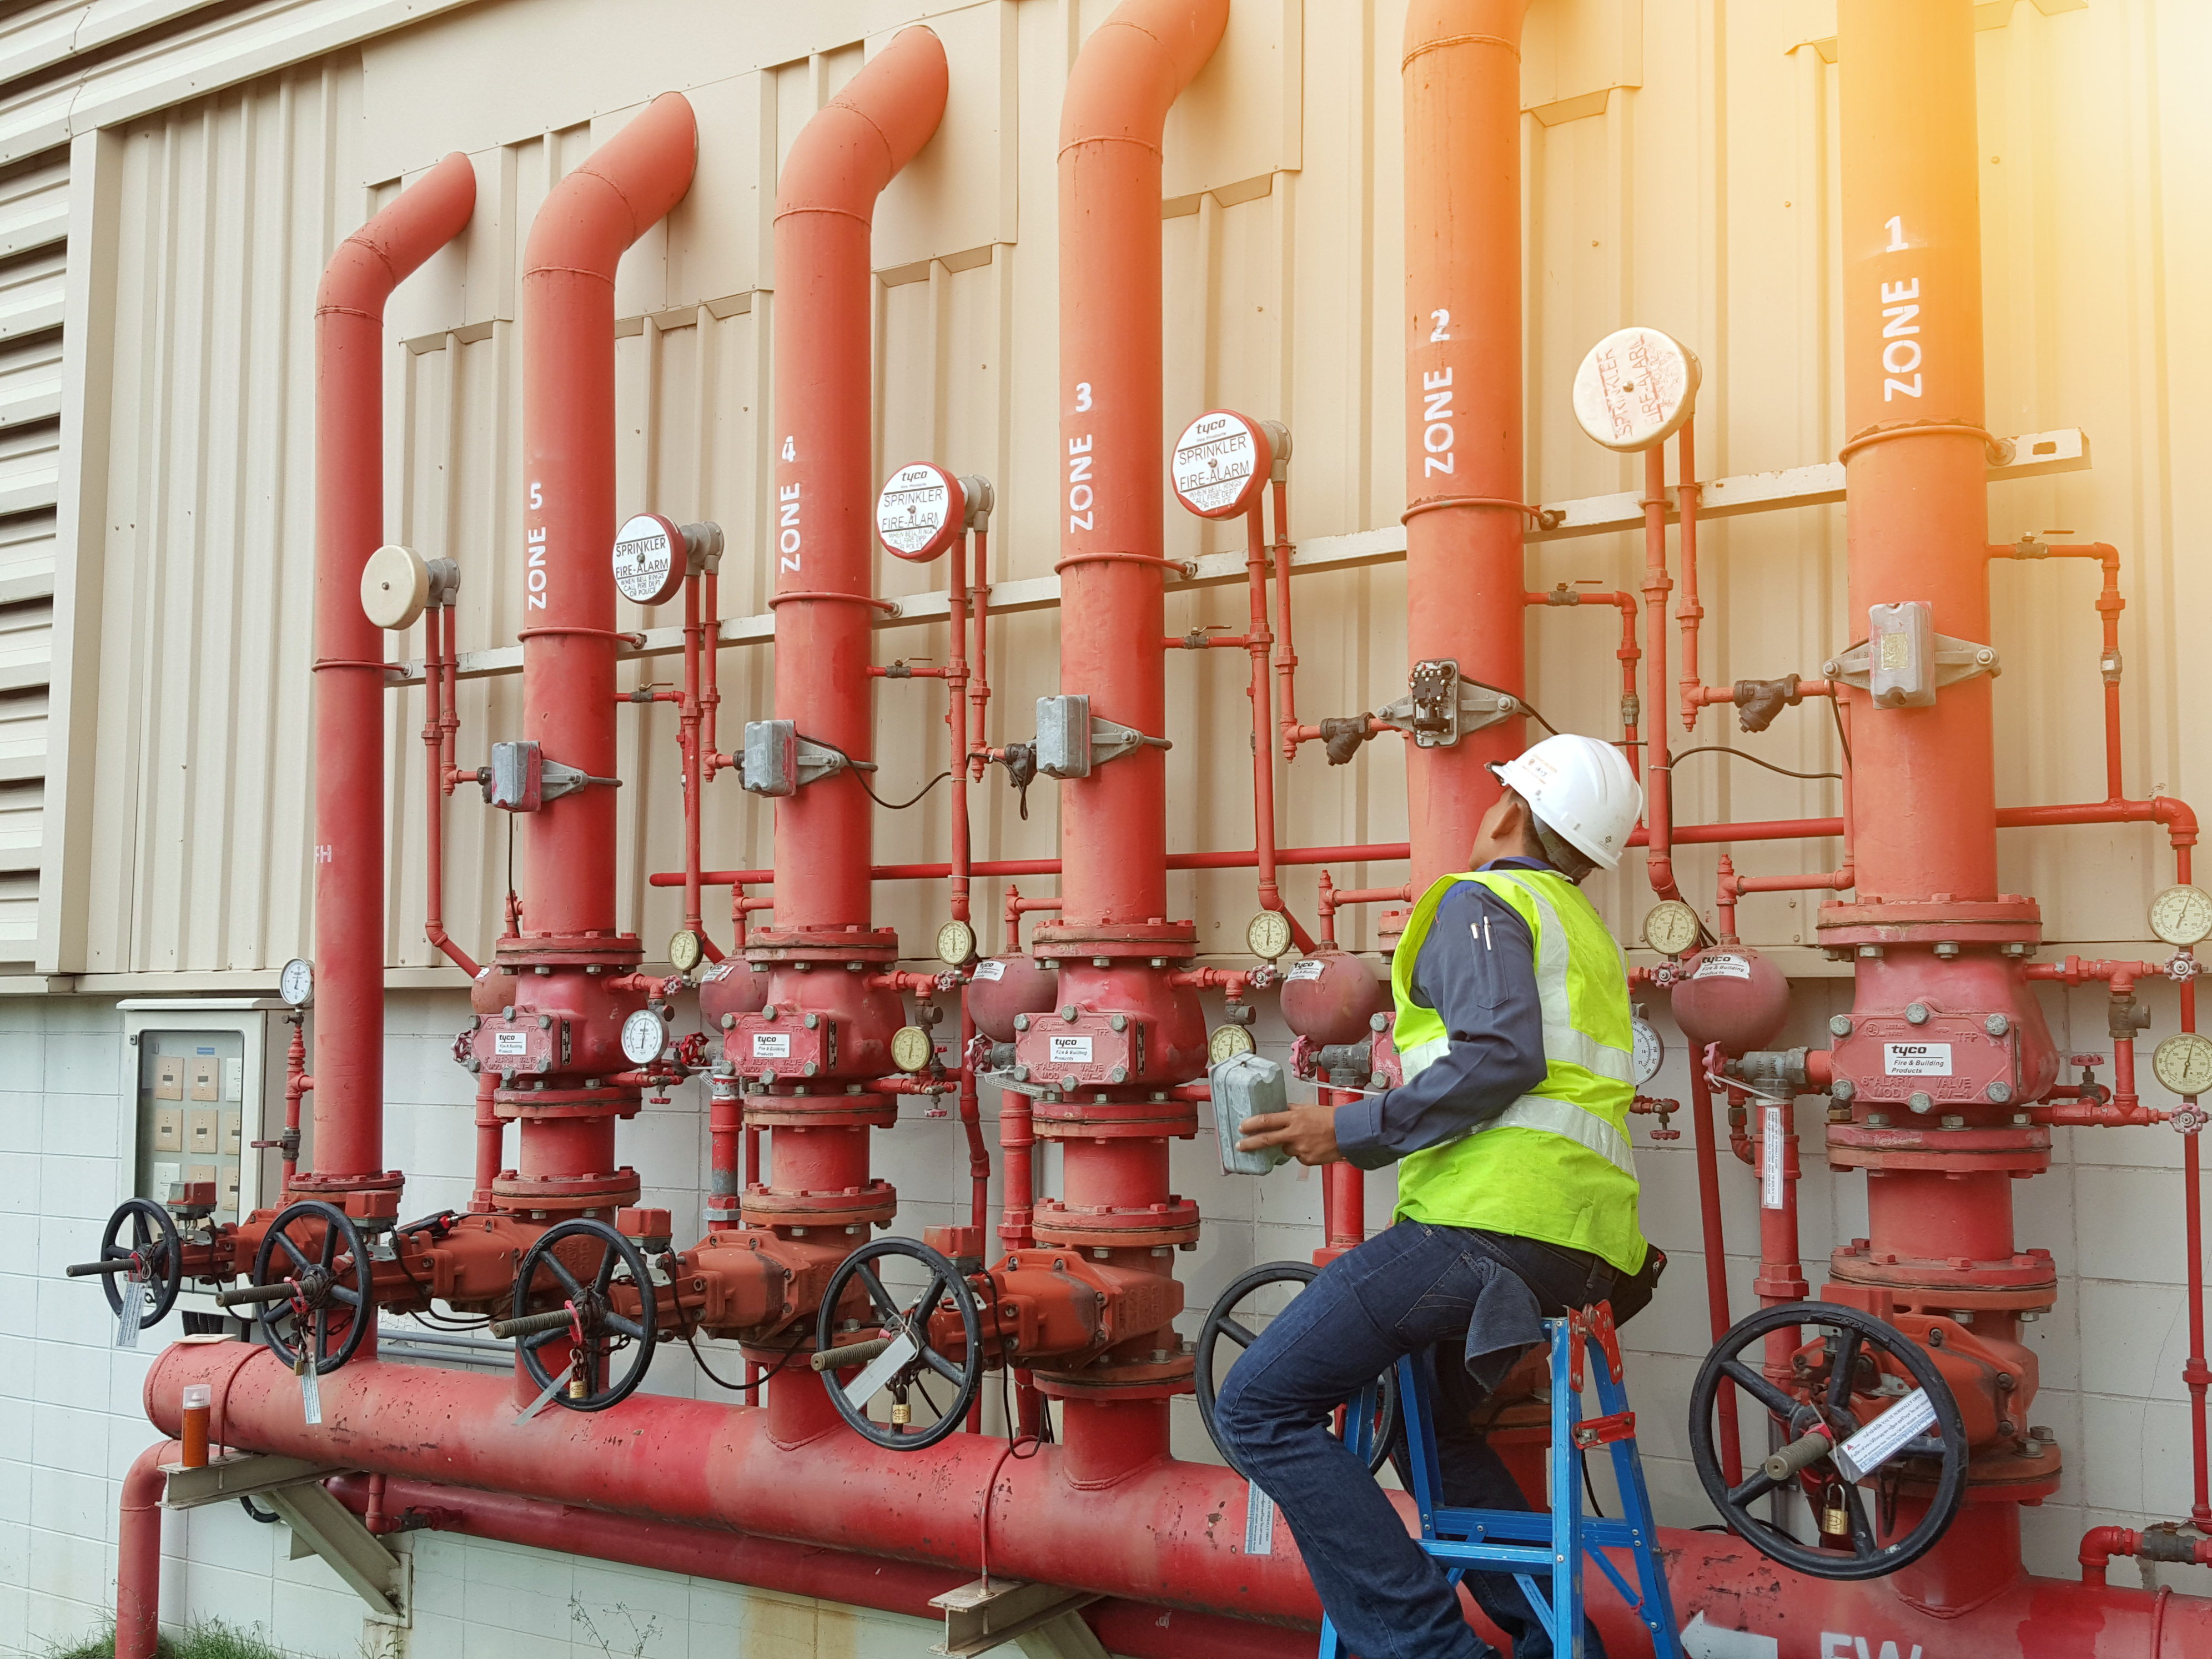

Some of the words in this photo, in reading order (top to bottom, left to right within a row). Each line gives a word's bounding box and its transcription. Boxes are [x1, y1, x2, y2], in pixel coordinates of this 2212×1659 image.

[1884, 215, 1908, 253] 1
[1430, 309, 1450, 343] 2
[1881, 277, 1922, 402] ZONE
[1075, 382, 1092, 412] 3
[1196, 419, 1226, 434] tyco
[1424, 366, 1454, 478] ZONE
[781, 435, 796, 462] 4
[1179, 436, 1246, 465] SPRINKLER
[901, 471, 927, 482] tyco
[1069, 434, 1093, 534] ZONE
[1180, 460, 1249, 490] FIRE-ALARM
[530, 482, 543, 510] 5
[884, 489, 942, 507] SPRINKLER
[780, 482, 801, 574] ZONE
[616, 537, 666, 557] SPRINKLER
[528, 526, 546, 611] ZONE
[616, 558, 668, 577] FIRE-ALARM
[1055, 1038, 1077, 1047] tyco
[1892, 1045, 1927, 1056] tyco
[1955, 1032, 1978, 1042] TFP
[1892, 1400, 1913, 1416] NORMALLY
[1912, 1392, 1922, 1402] OPEN
